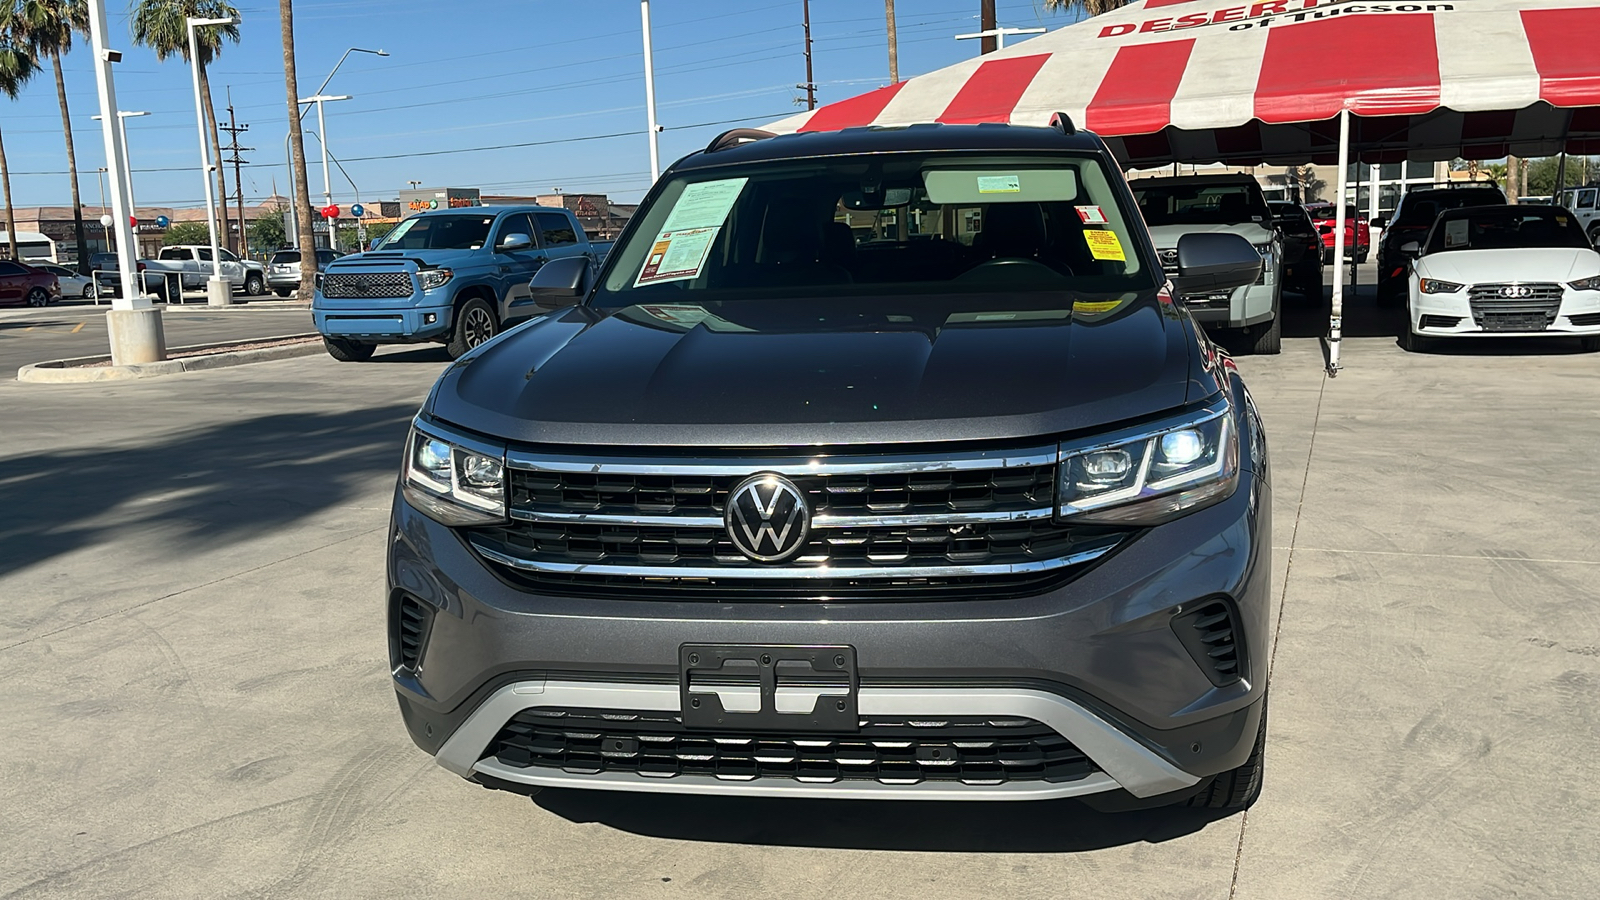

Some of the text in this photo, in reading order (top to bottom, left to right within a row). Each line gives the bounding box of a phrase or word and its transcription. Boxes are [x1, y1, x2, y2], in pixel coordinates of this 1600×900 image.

[1229, 4, 1454, 31] of Tucson
[729, 477, 804, 556] VW
